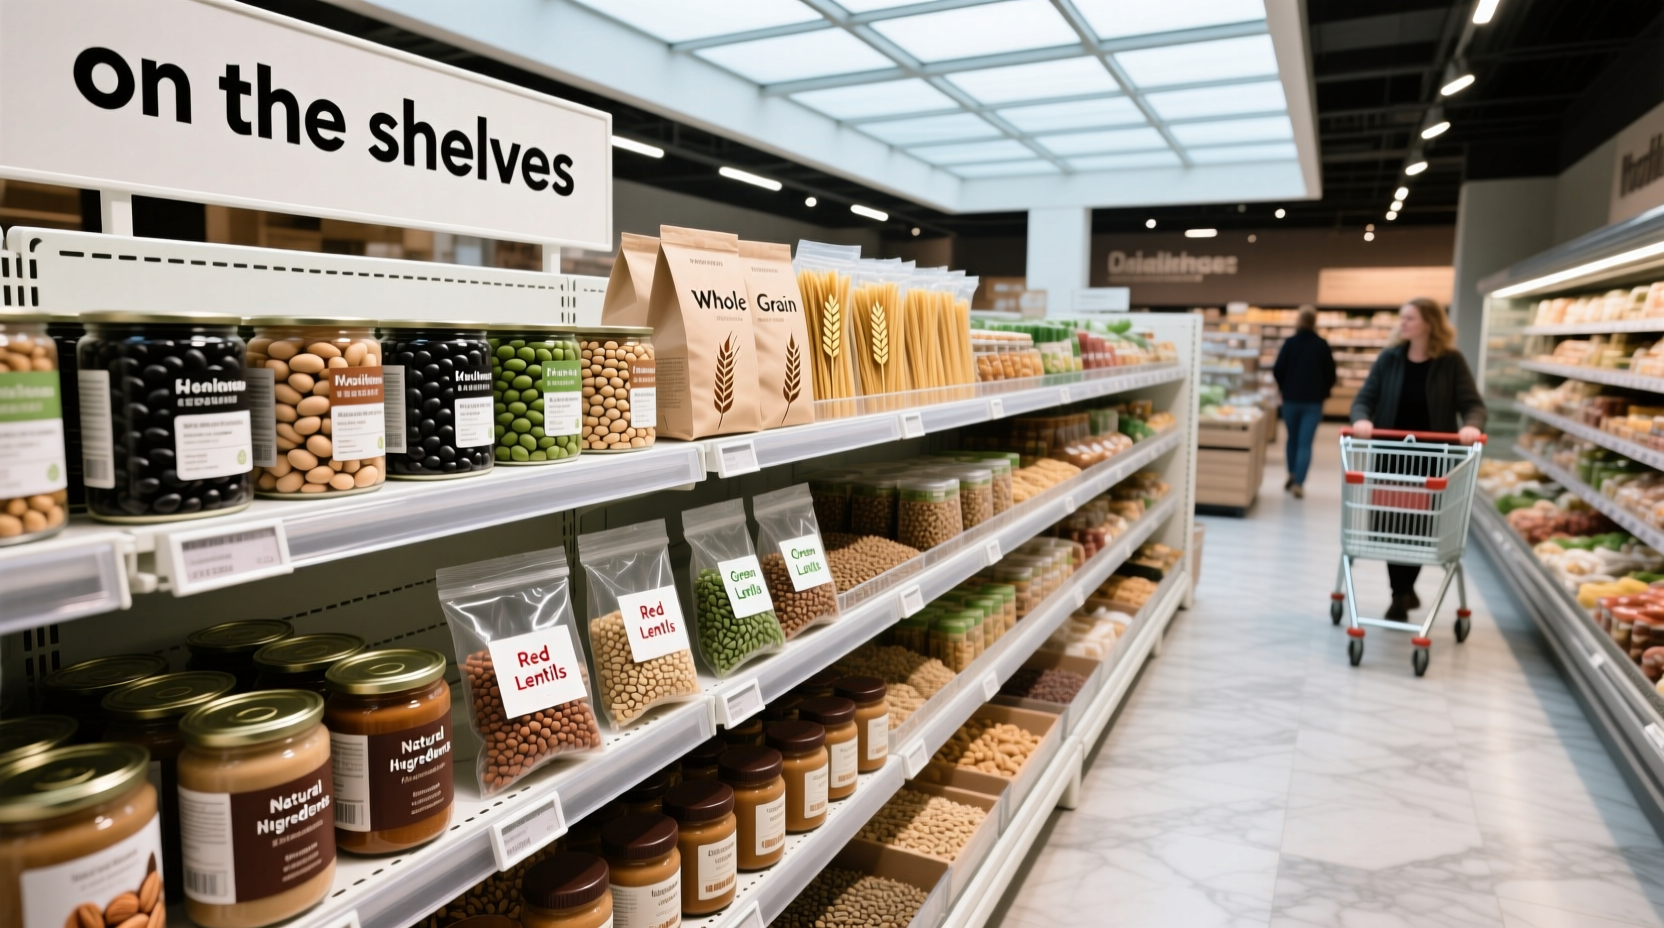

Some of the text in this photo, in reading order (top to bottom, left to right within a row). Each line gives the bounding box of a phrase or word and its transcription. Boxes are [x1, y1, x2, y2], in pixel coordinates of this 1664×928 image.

[73, 46, 575, 197] on the shelves
[691, 290, 747, 311] Whole
[757, 293, 798, 312] Grain
[639, 602, 665, 620] Red
[517, 645, 551, 668] Red
[515, 664, 567, 691] Lentils
[402, 725, 444, 755] Natural
[269, 778, 322, 814] Natural
